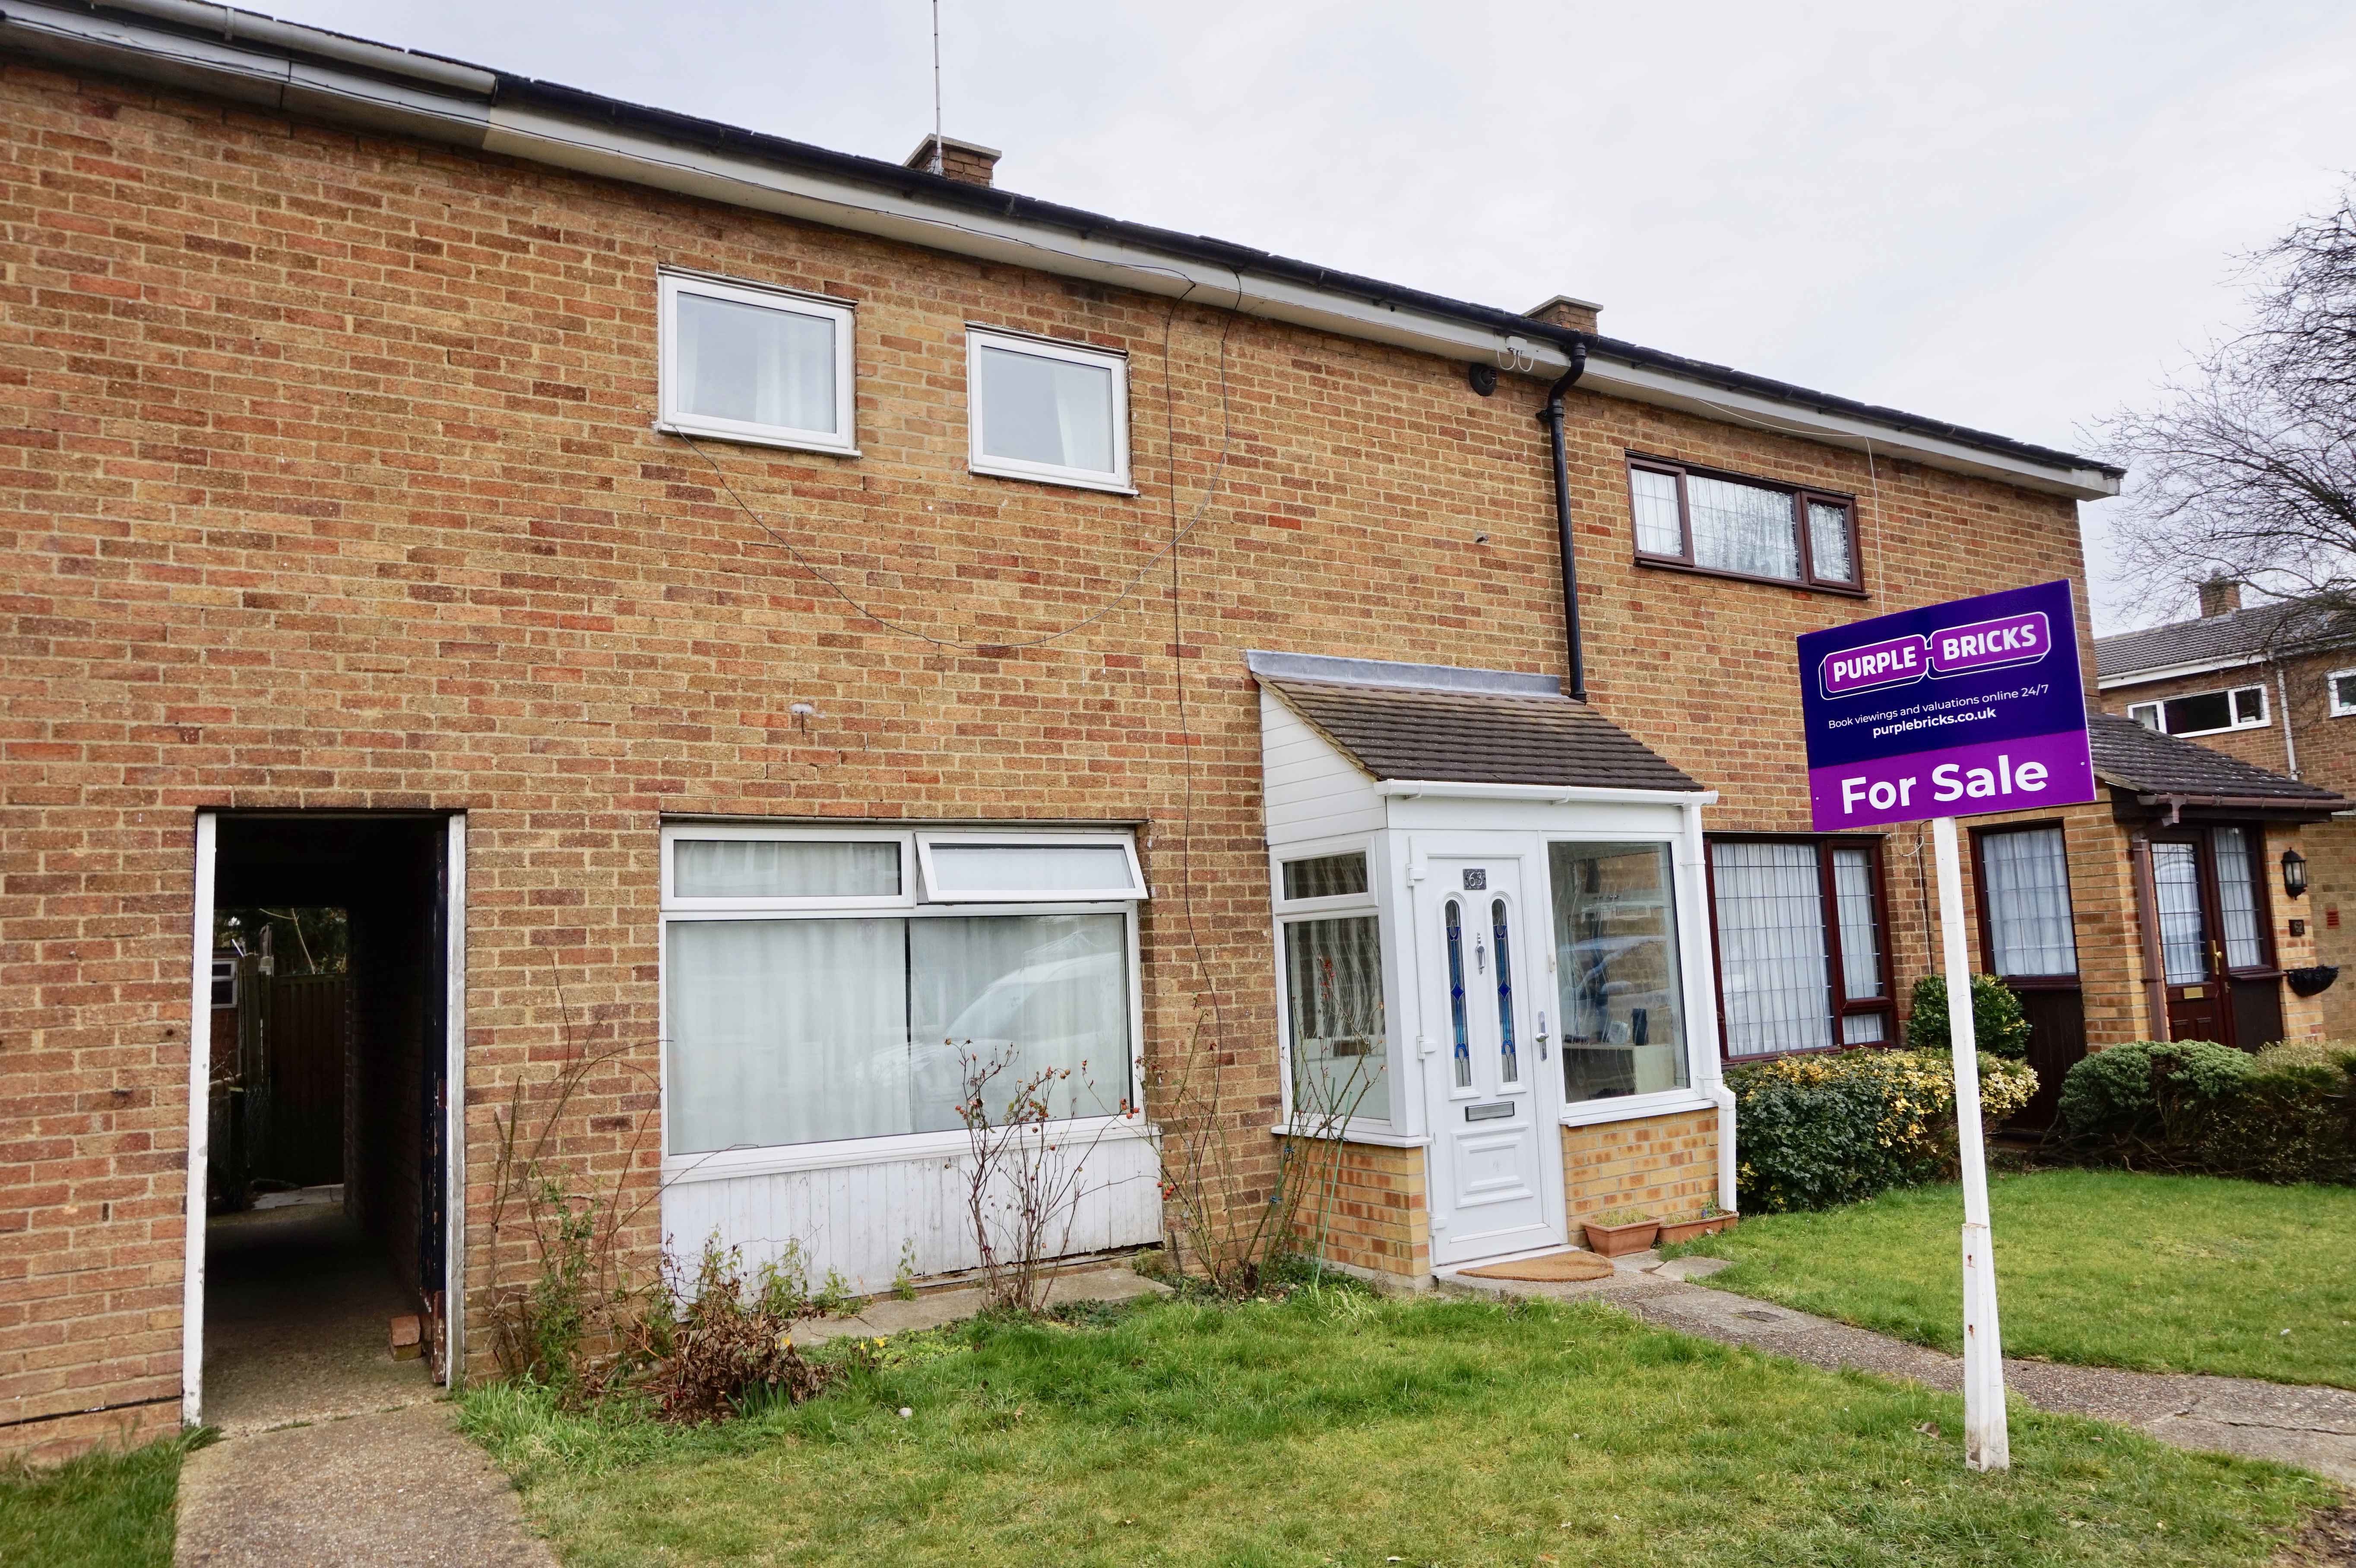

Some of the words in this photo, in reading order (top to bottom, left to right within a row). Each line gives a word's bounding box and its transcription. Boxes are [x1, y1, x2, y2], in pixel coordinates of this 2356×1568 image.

[1834, 646, 1917, 682] PURPLE
[1943, 624, 2037, 661] BRICKS
[1828, 717, 1853, 729] Book
[1855, 710, 1898, 724] viewings
[1900, 704, 1920, 716] and
[1922, 697, 1979, 712] valuations
[1982, 691, 2019, 703] online
[2021, 684, 2049, 697] 24/7
[1872, 707, 1997, 739] purplebricks.co.uk
[1841, 776, 1916, 814] For
[1932, 754, 2049, 802] Sale
[1469, 872, 1482, 886] 63
